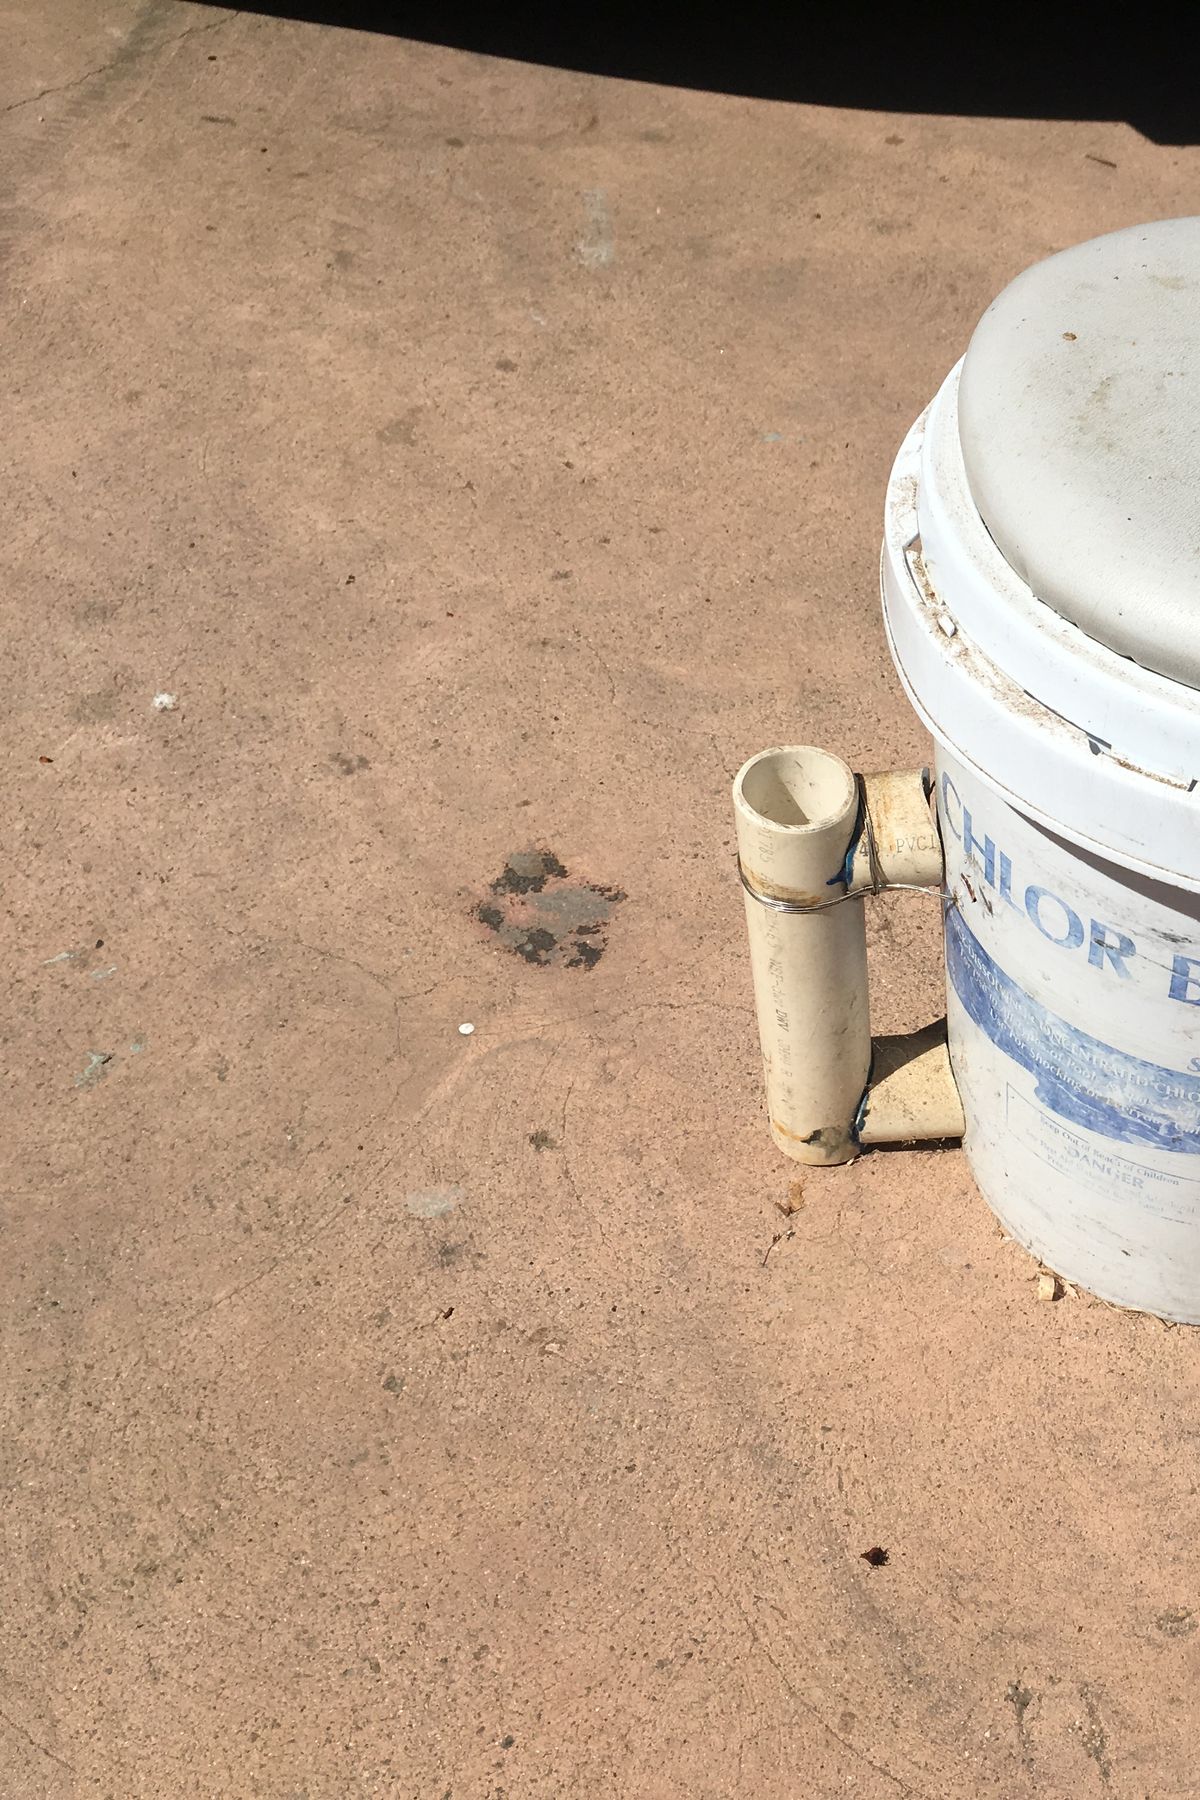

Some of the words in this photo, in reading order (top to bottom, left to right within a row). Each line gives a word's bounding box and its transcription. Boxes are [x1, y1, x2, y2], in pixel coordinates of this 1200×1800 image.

[942, 771, 1136, 979] CHLOR
[1029, 1049, 1083, 1093] Shocking
[1062, 1130, 1079, 1146] Out
[1136, 1167, 1181, 1186] Children
[1064, 1147, 1145, 1190] DANGER
